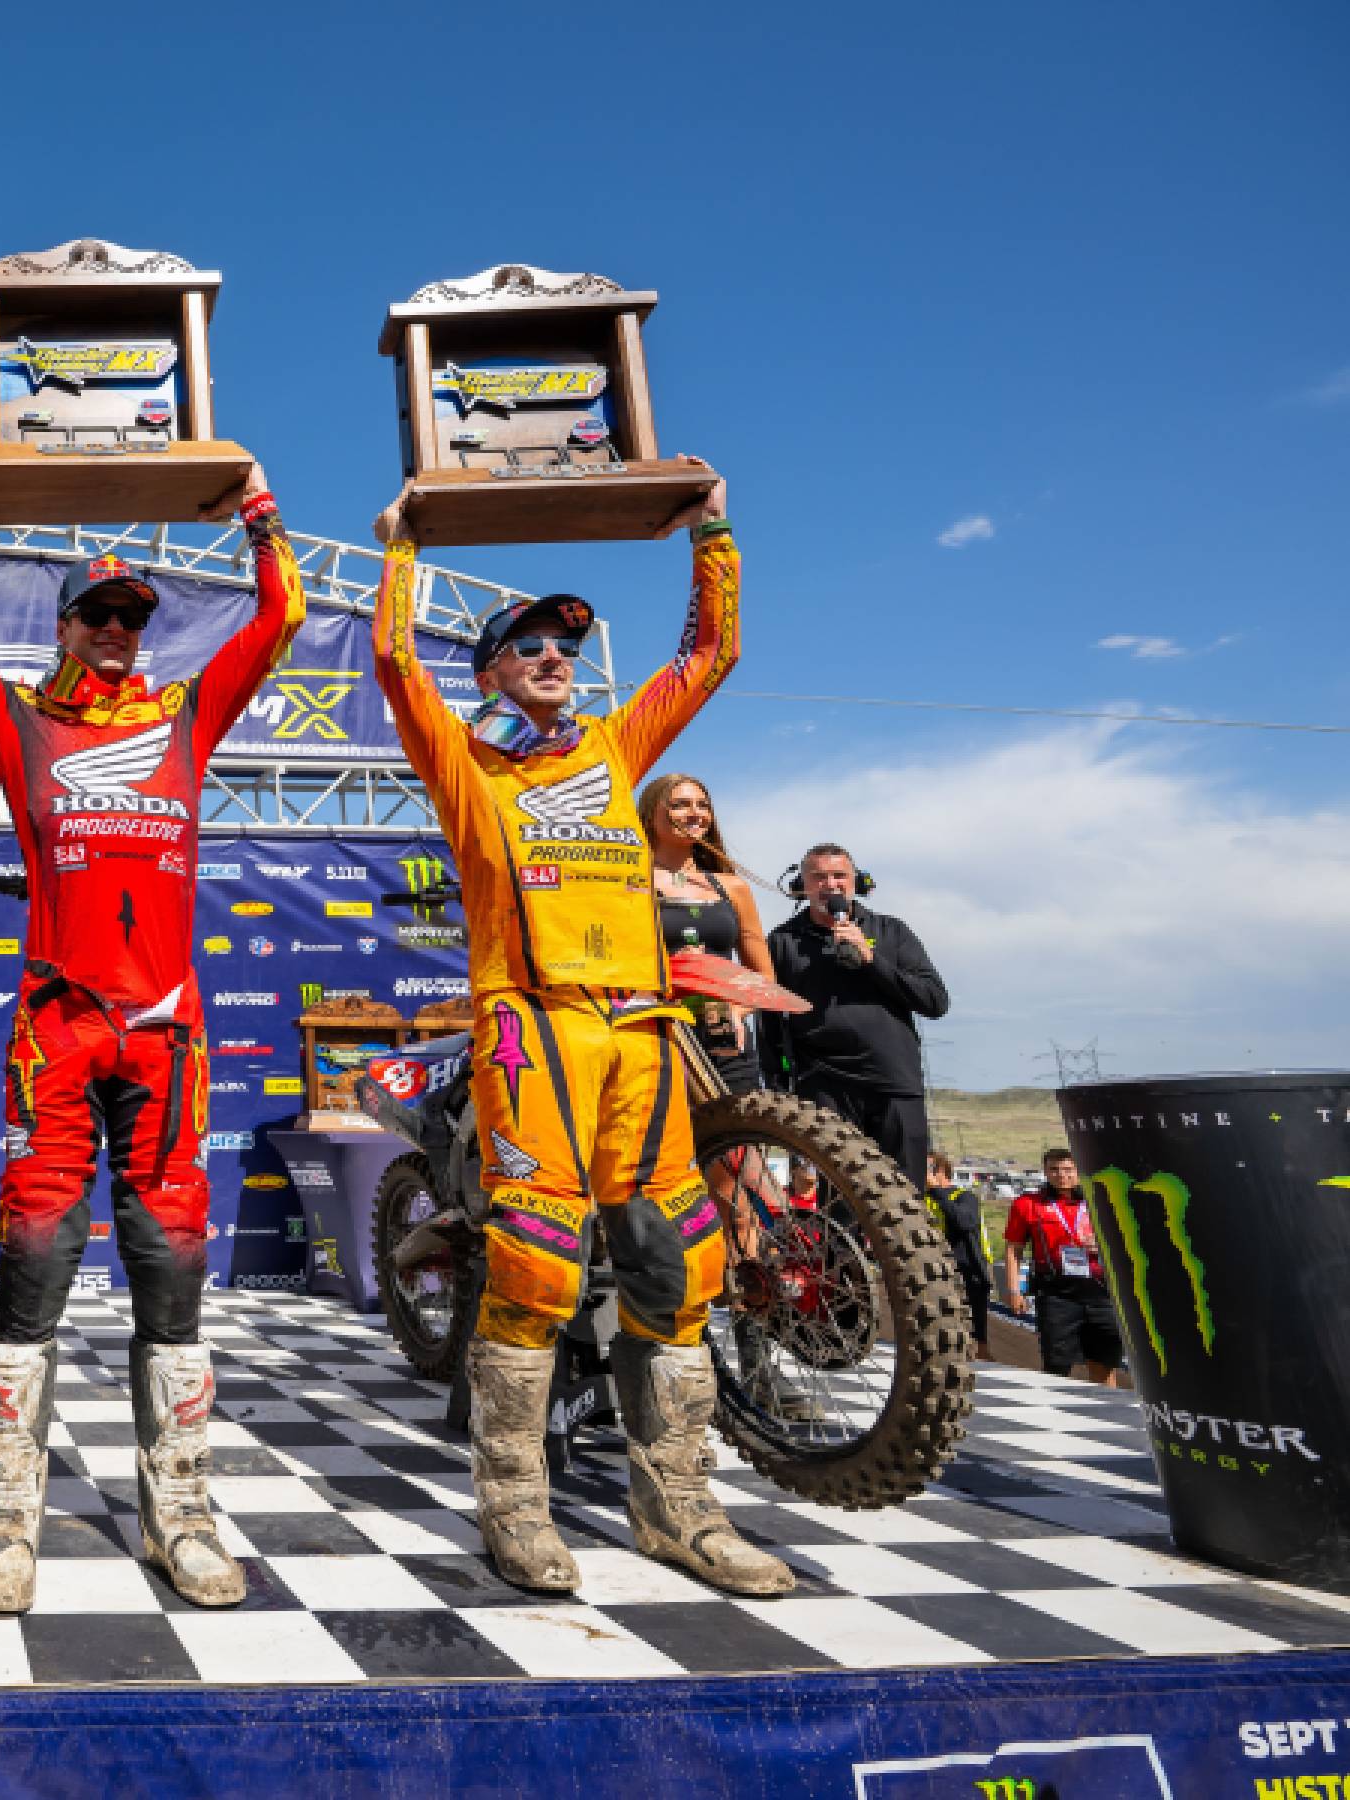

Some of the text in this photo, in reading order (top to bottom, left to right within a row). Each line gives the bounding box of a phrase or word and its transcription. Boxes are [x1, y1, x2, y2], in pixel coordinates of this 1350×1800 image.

[50, 795, 189, 820] HONDA
[58, 817, 184, 842] PROGRESSIVE
[519, 822, 642, 847] HONDA
[1239, 1719, 1337, 1757] SEPT
